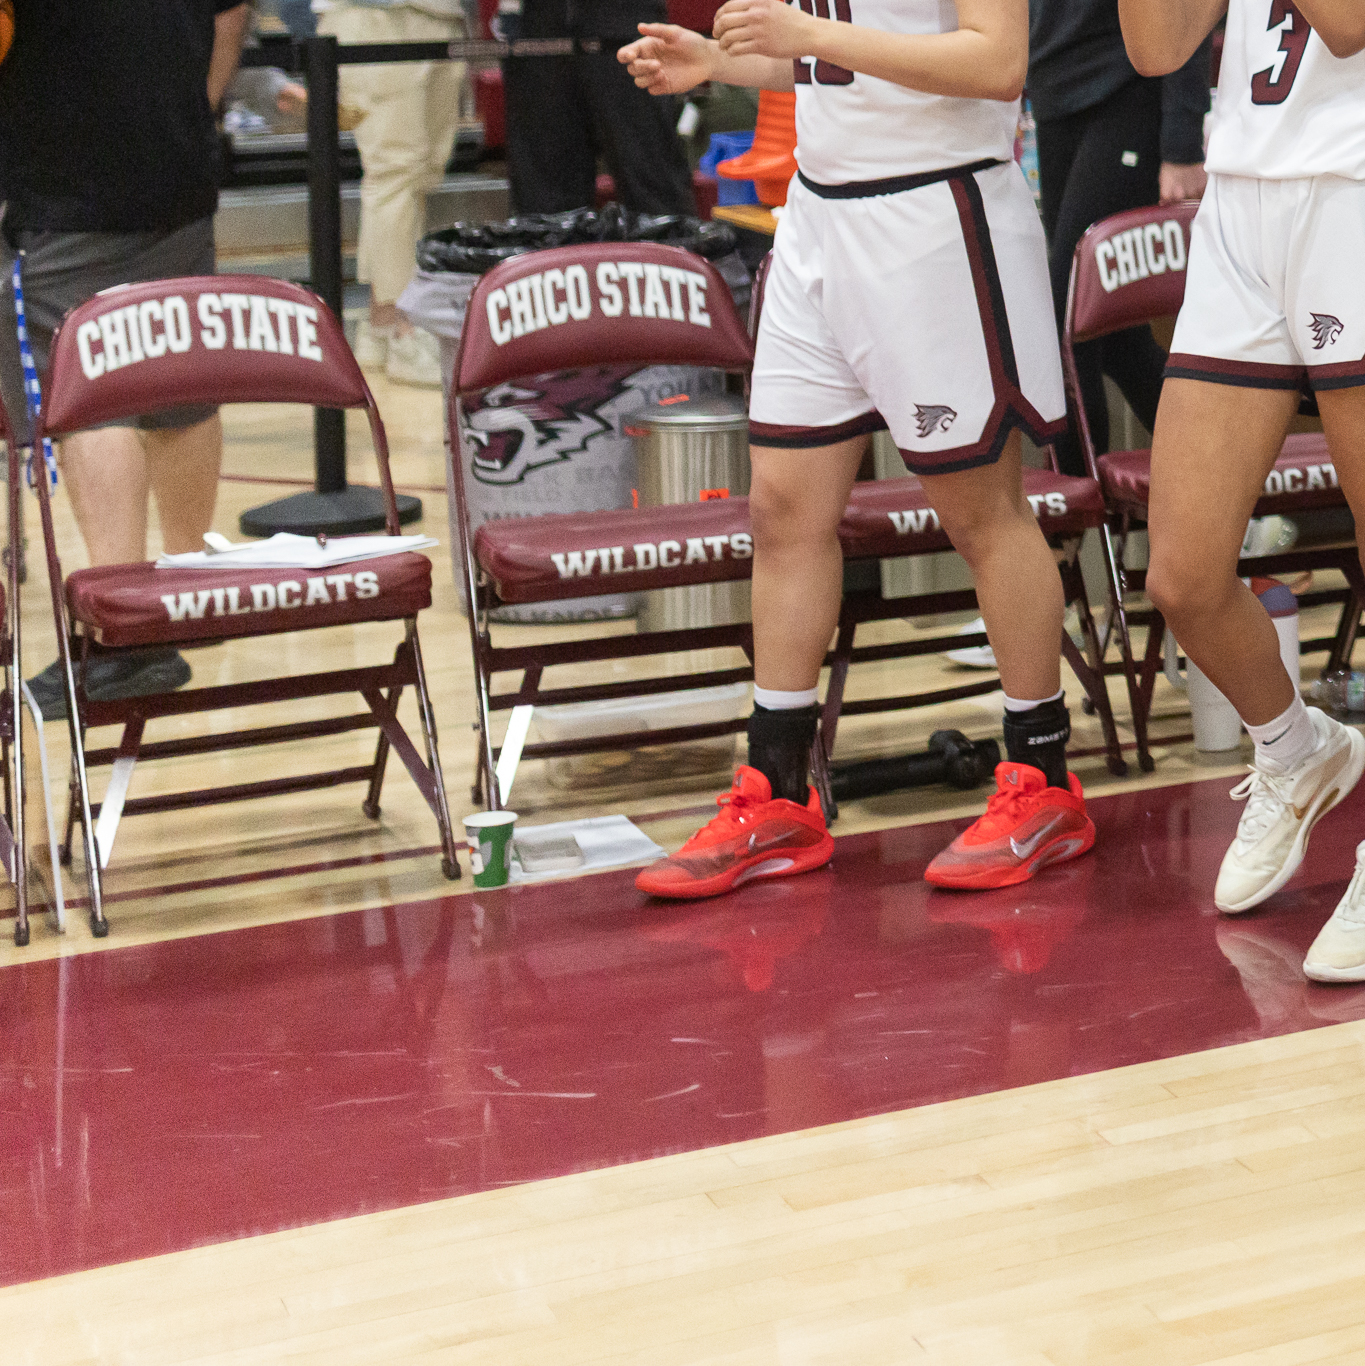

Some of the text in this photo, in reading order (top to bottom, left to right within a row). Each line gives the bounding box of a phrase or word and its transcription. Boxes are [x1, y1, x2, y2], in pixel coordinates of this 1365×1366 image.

[1095, 219, 1187, 293] CHICO
[77, 293, 324, 381] CHICO STATE
[486, 261, 712, 346] CHICO STATE
[551, 532, 753, 580] WILDCATS
[160, 571, 380, 622] WILDCATS
